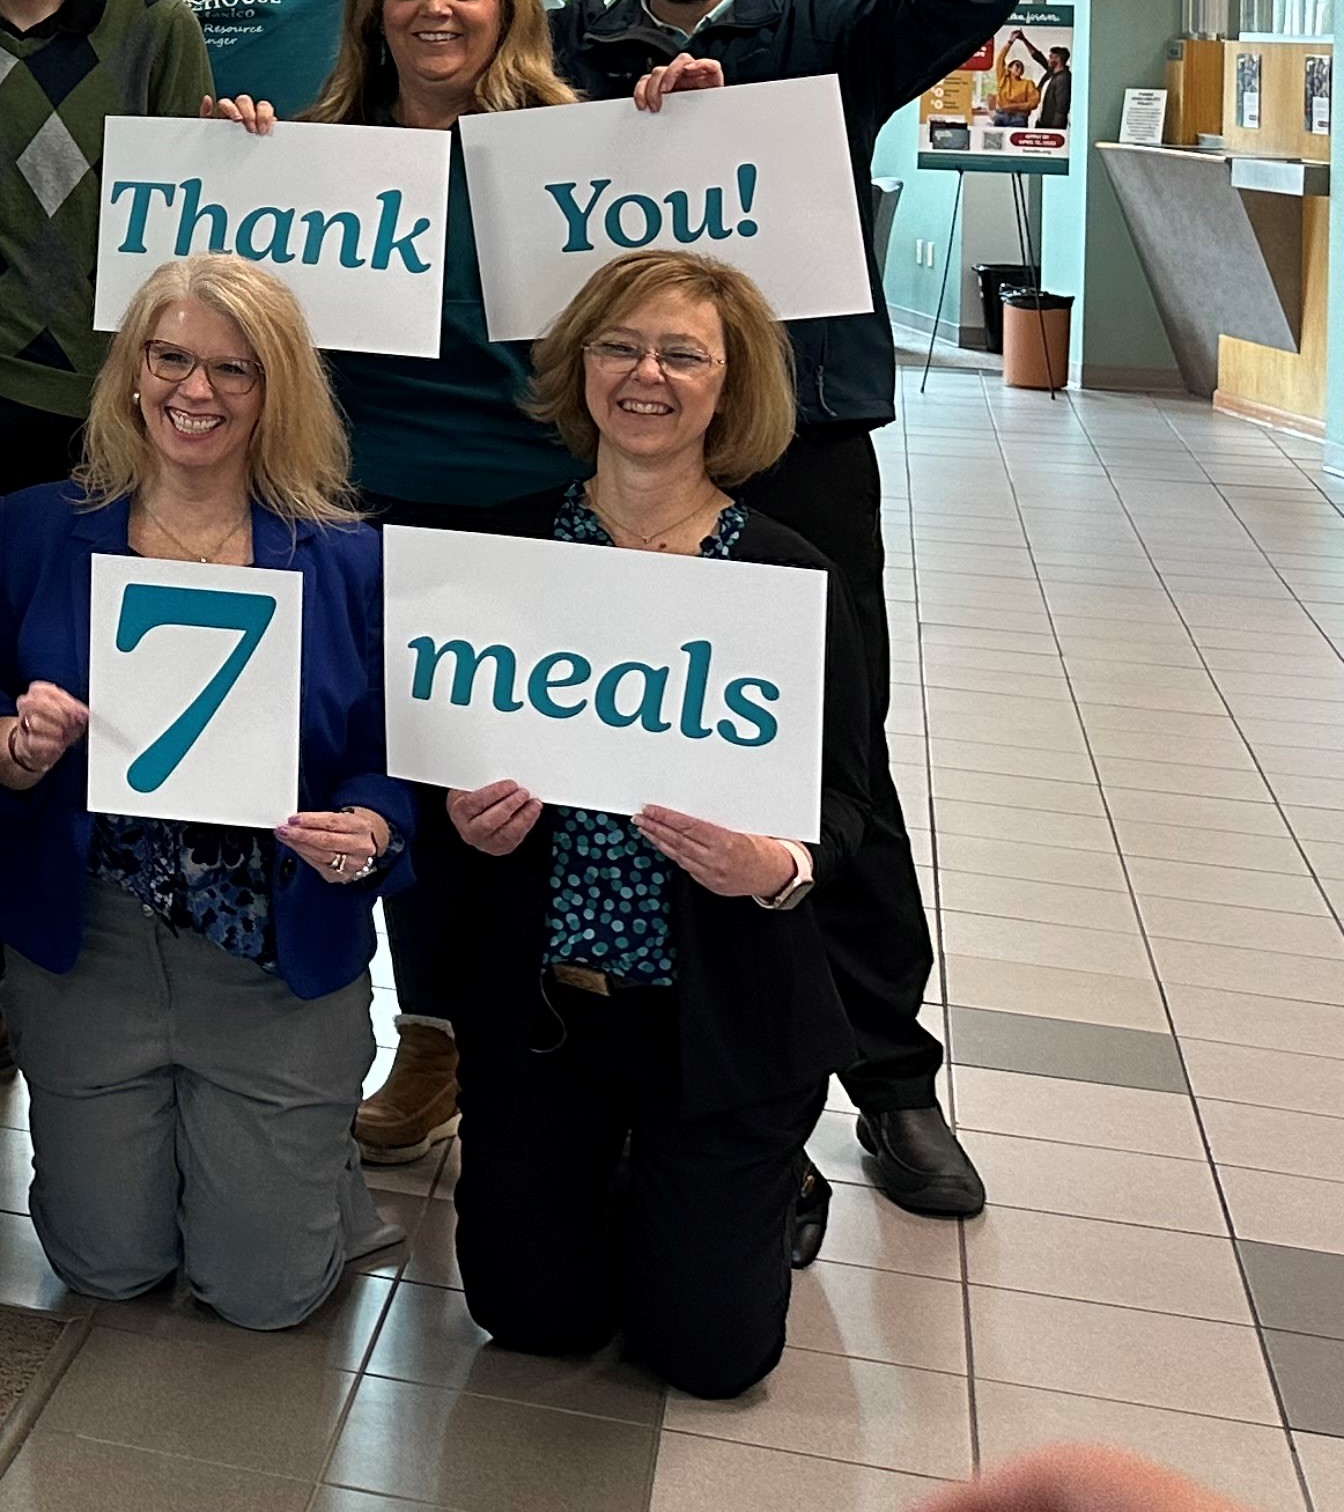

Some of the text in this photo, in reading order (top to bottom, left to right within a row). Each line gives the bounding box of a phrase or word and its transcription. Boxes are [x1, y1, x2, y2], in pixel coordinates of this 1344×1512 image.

[111, 178, 430, 274] Thank
[546, 163, 759, 252] You!
[116, 583, 276, 793] 7
[408, 636, 780, 747] meals
